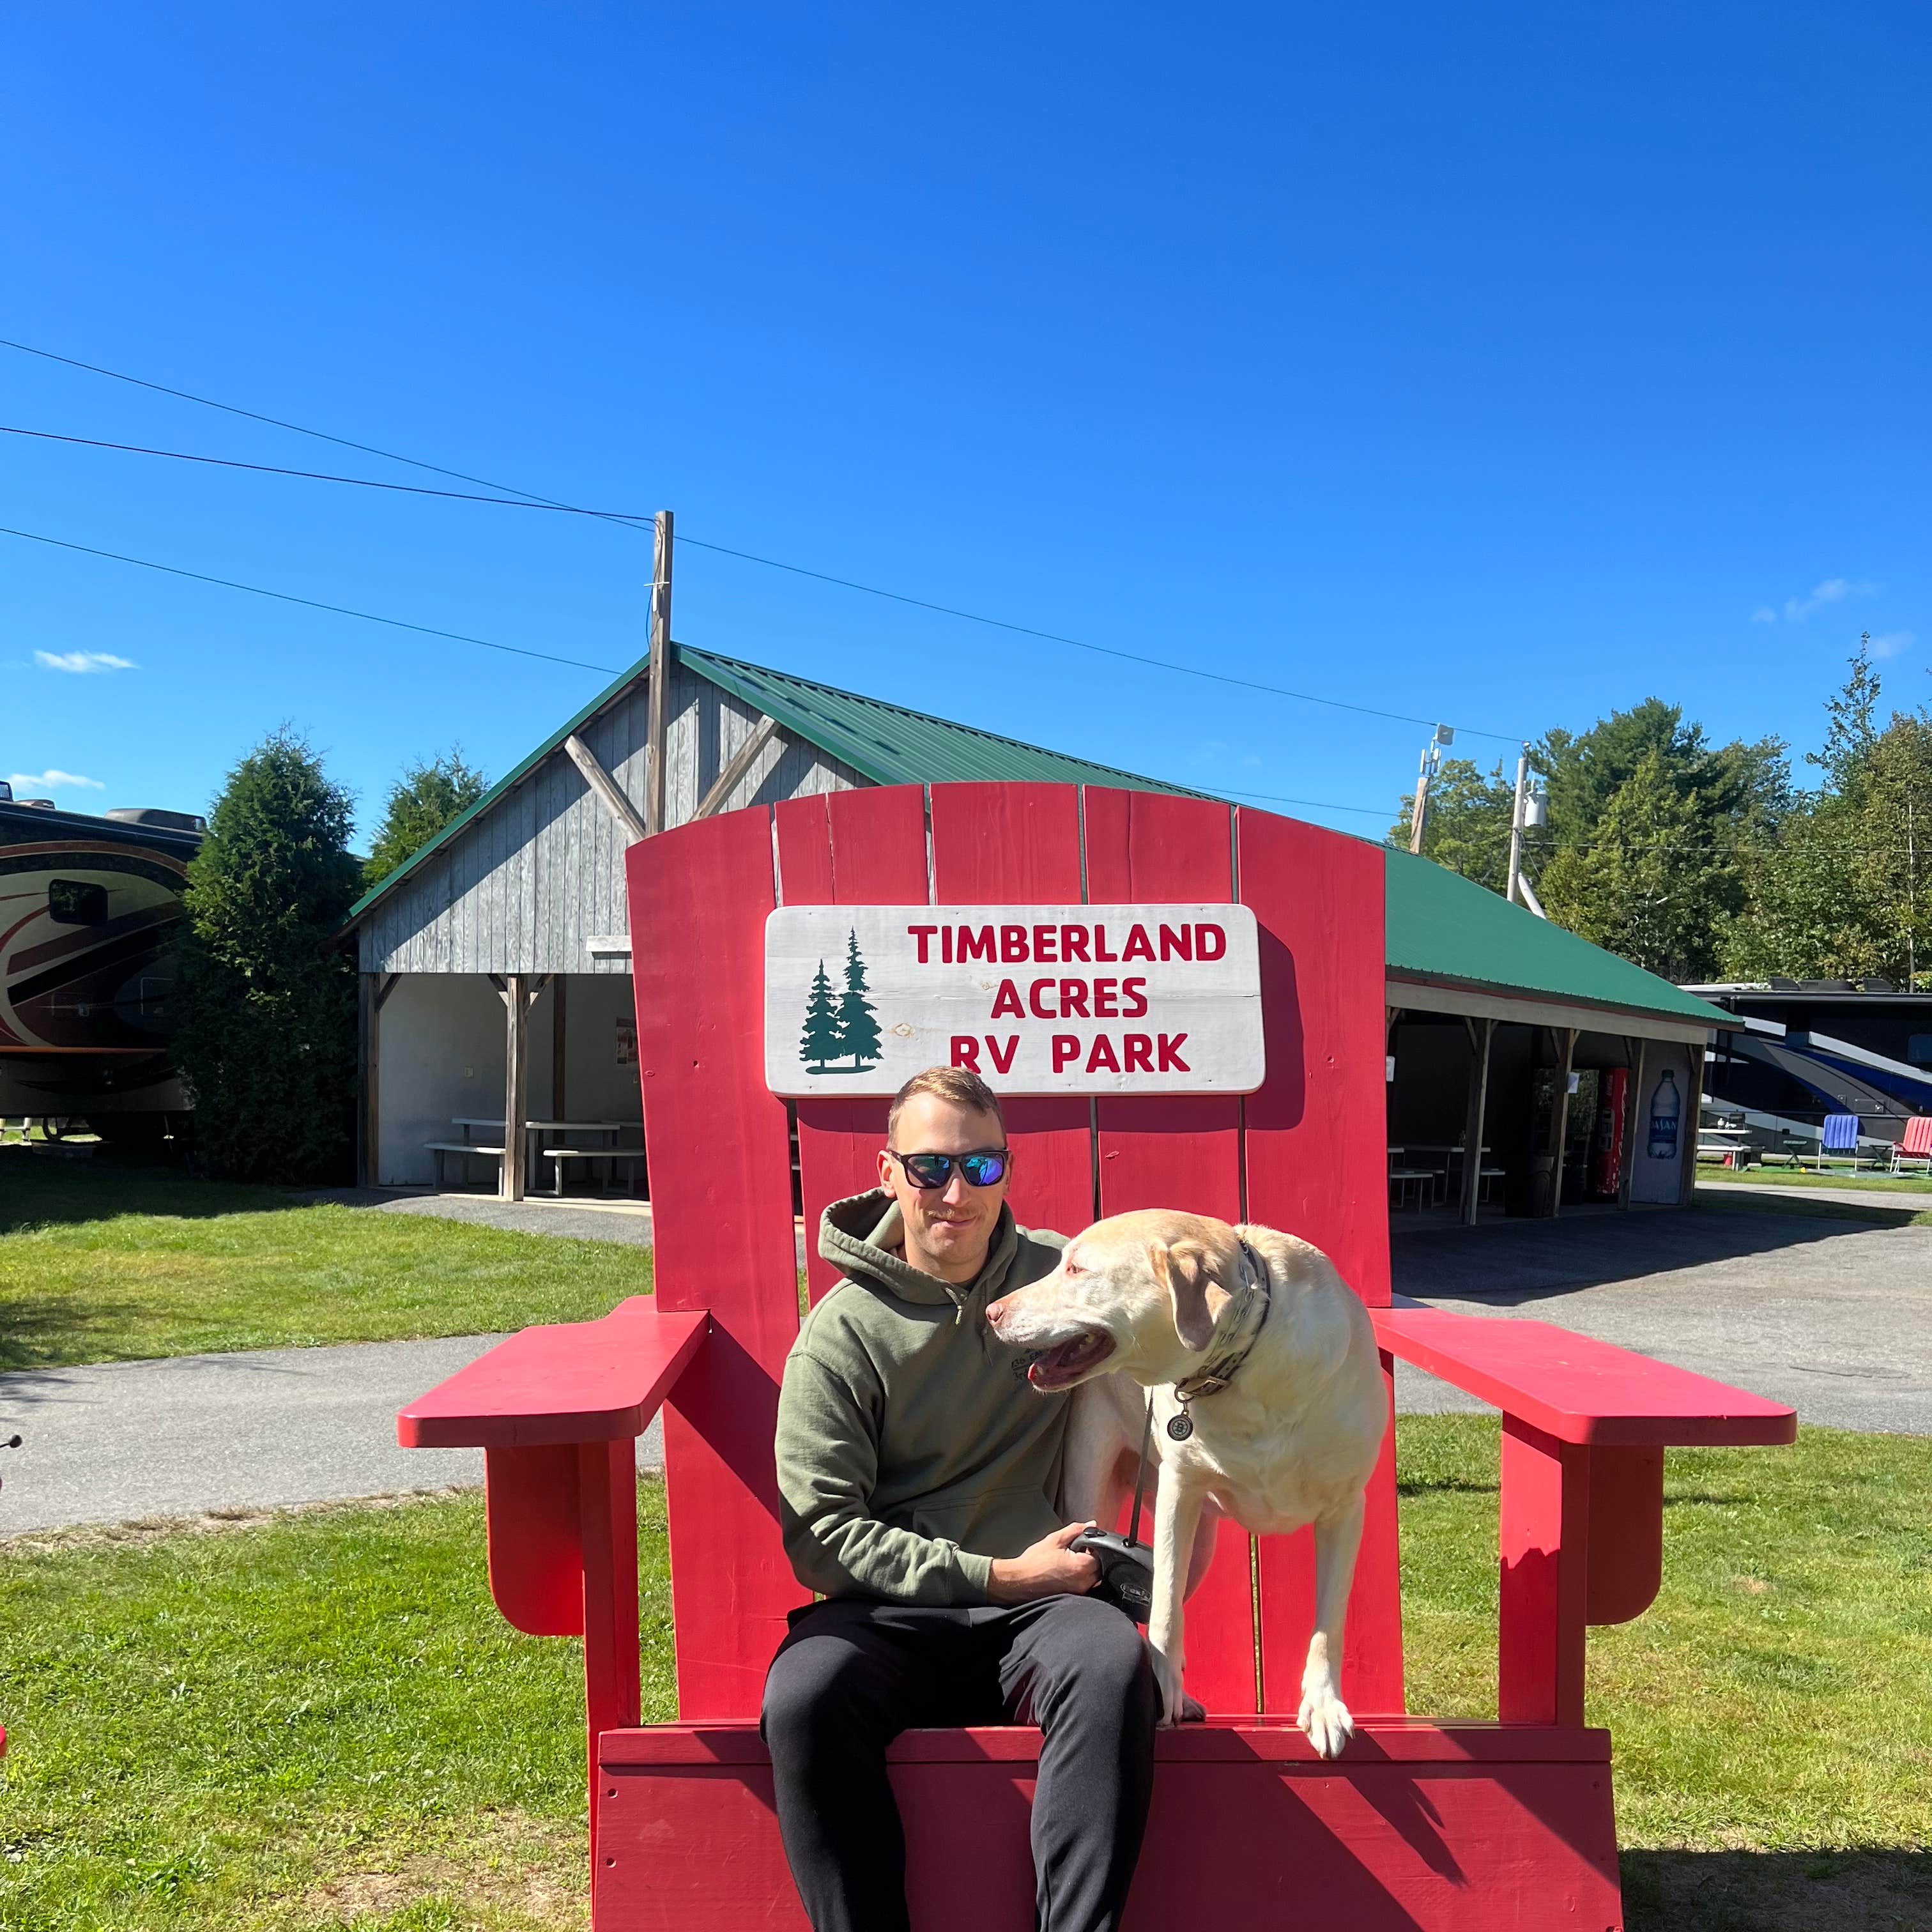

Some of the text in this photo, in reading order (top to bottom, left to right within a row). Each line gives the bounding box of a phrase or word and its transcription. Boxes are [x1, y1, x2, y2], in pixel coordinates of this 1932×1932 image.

[907, 924, 1227, 964] TIMBERLAND
[991, 977, 1147, 1019] ACRES
[950, 1033, 1191, 1075] RV PARK
